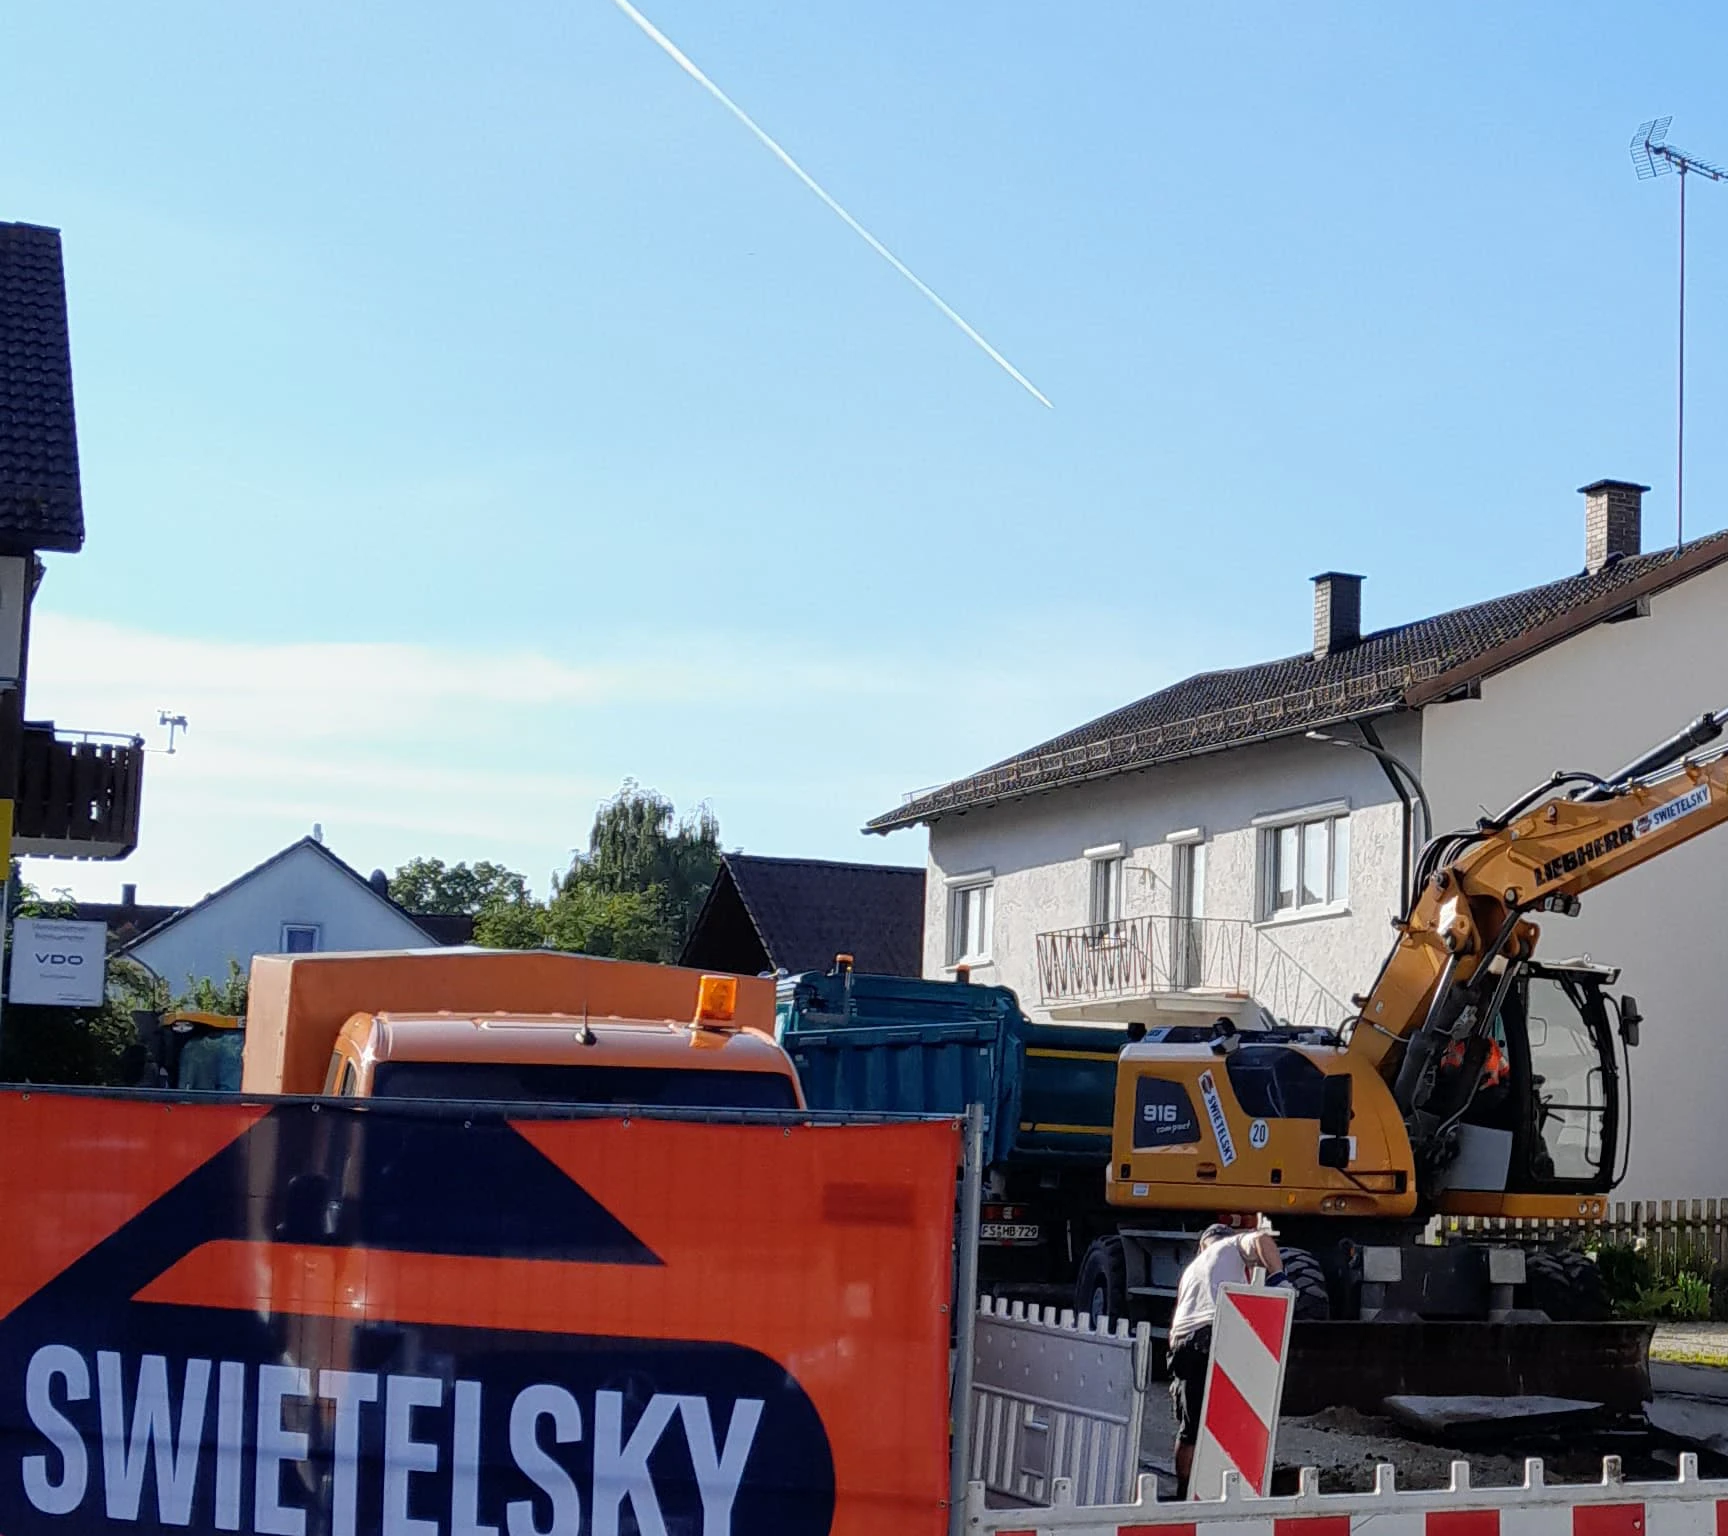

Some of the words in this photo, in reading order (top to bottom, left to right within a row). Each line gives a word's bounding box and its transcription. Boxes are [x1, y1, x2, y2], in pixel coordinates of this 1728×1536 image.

[1653, 787, 1709, 825] SWIETELSKY
[1534, 823, 1635, 887] LIEBHERR
[35, 953, 84, 966] VDO
[1143, 1104, 1178, 1122] 916
[1207, 1095, 1234, 1163] SWIETELSKY
[1252, 1124, 1266, 1143] 20
